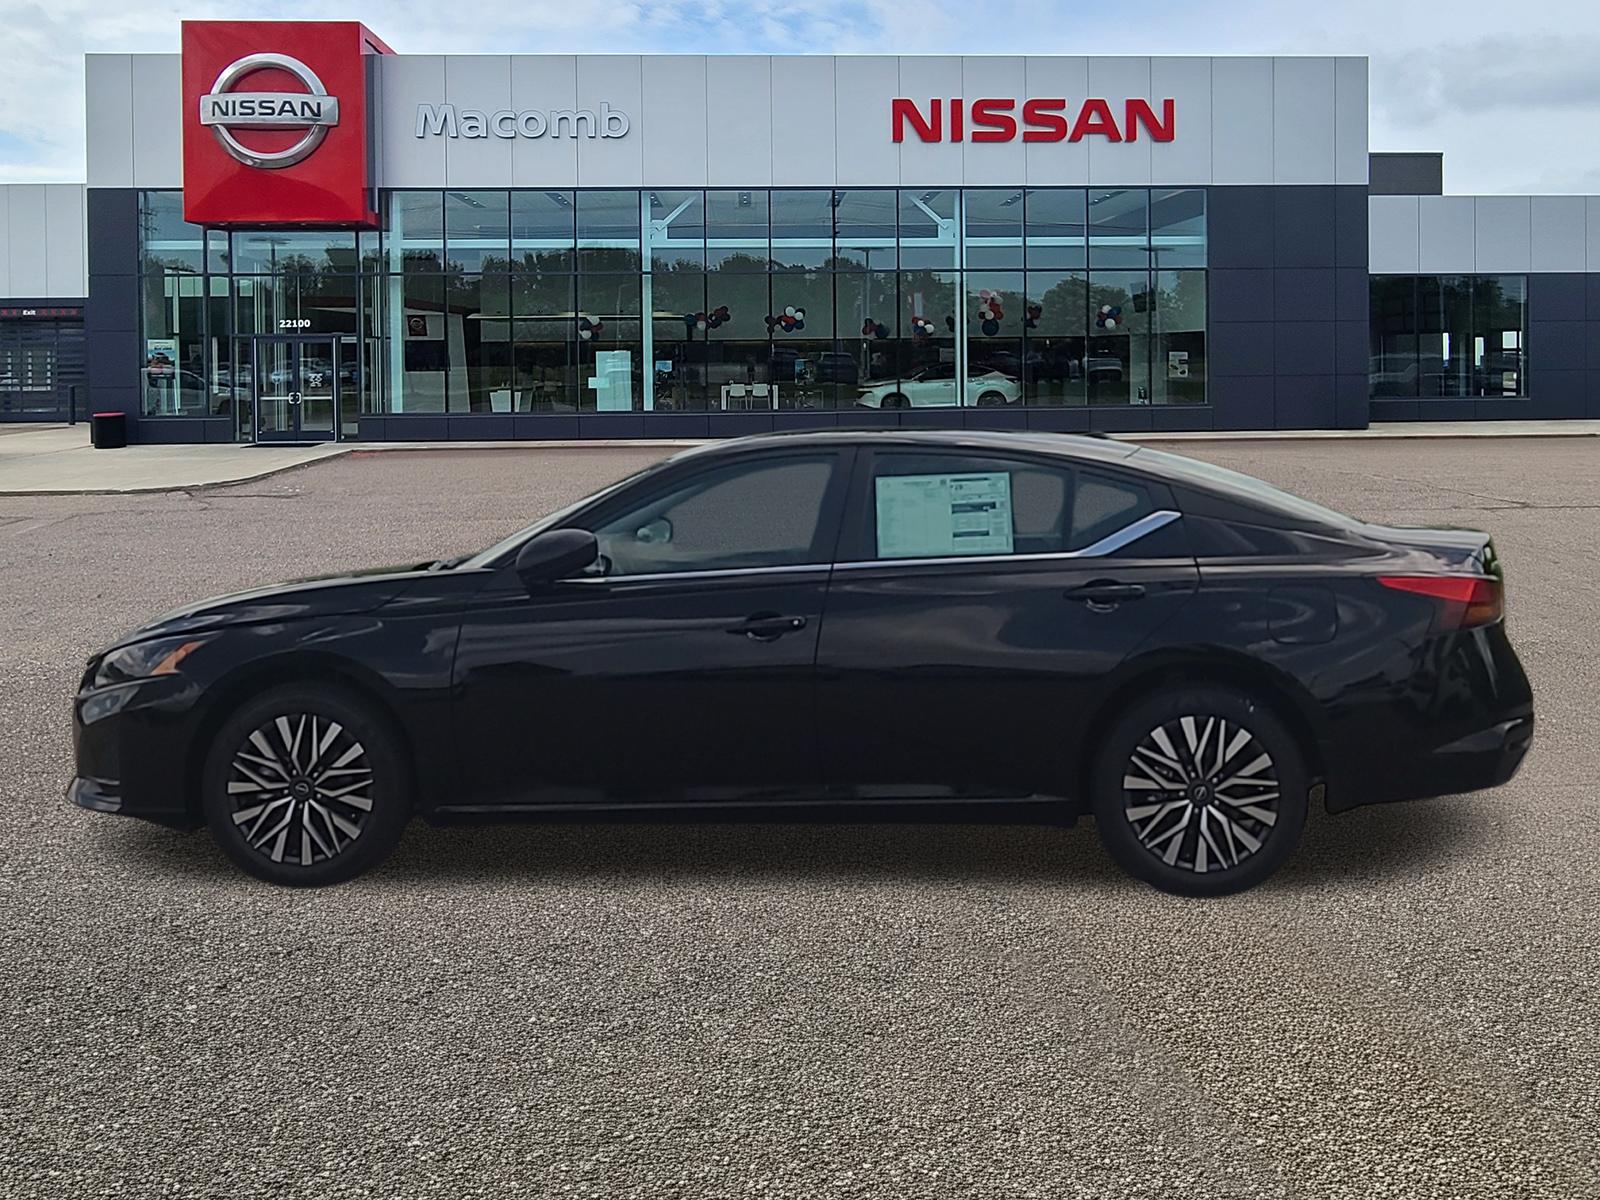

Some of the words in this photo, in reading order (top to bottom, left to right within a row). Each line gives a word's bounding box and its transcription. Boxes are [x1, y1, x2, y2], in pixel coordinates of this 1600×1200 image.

[211, 100, 322, 117] NISSAN
[415, 102, 630, 138] Macomb
[892, 98, 1175, 143] NISSAN
[279, 319, 311, 328] 22100
